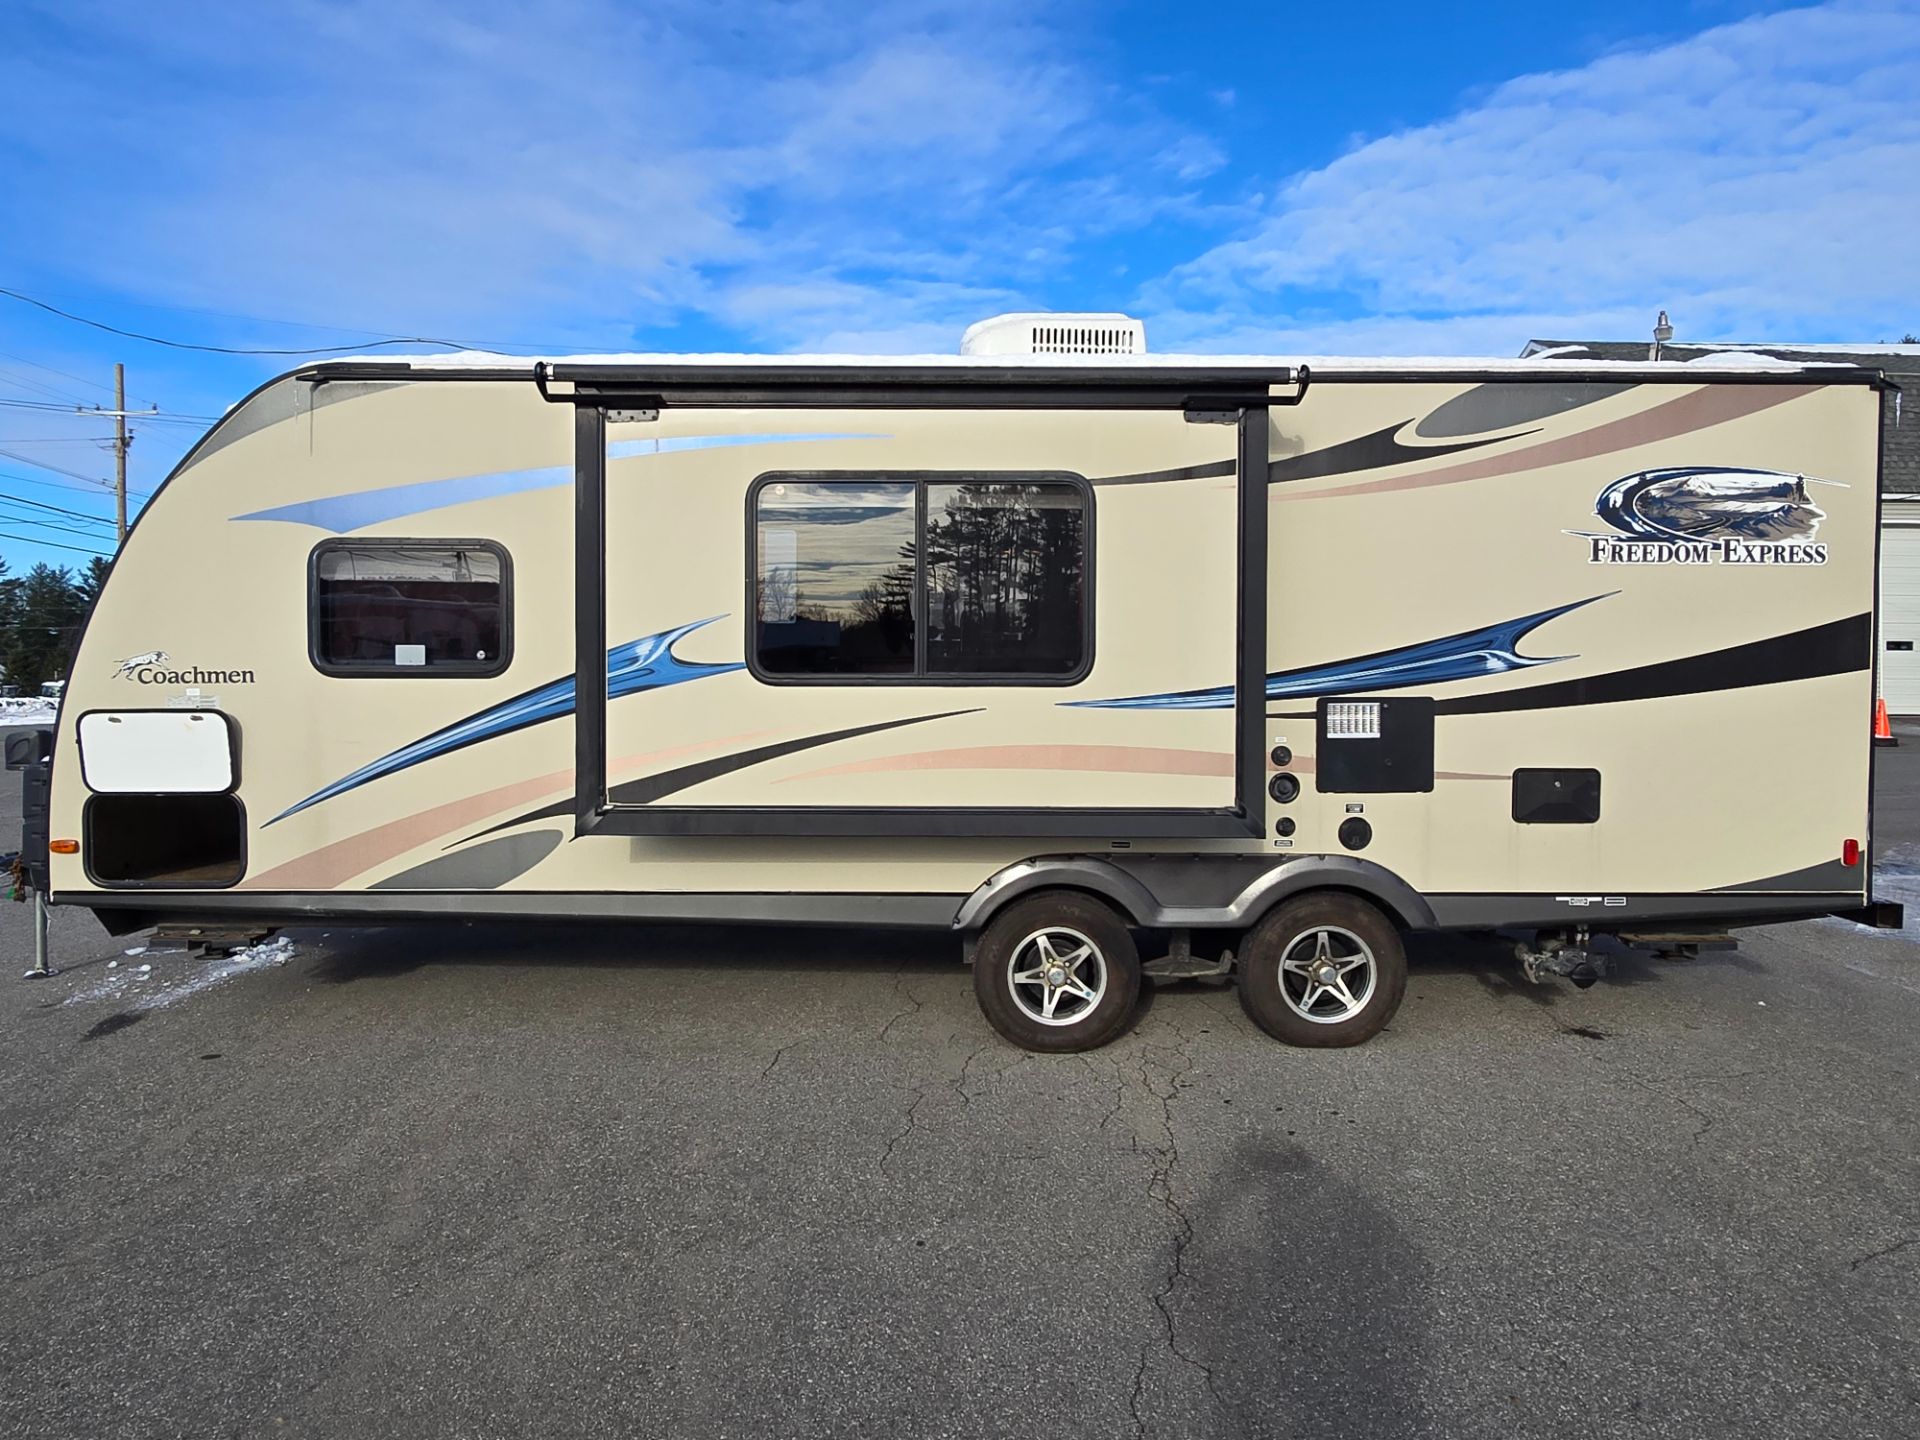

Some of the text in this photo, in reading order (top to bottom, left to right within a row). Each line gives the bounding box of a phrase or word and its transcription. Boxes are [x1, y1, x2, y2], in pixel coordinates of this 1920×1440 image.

[1590, 537, 1827, 563] FREEDOM EXPRESS
[137, 666, 255, 685] Coachmen
